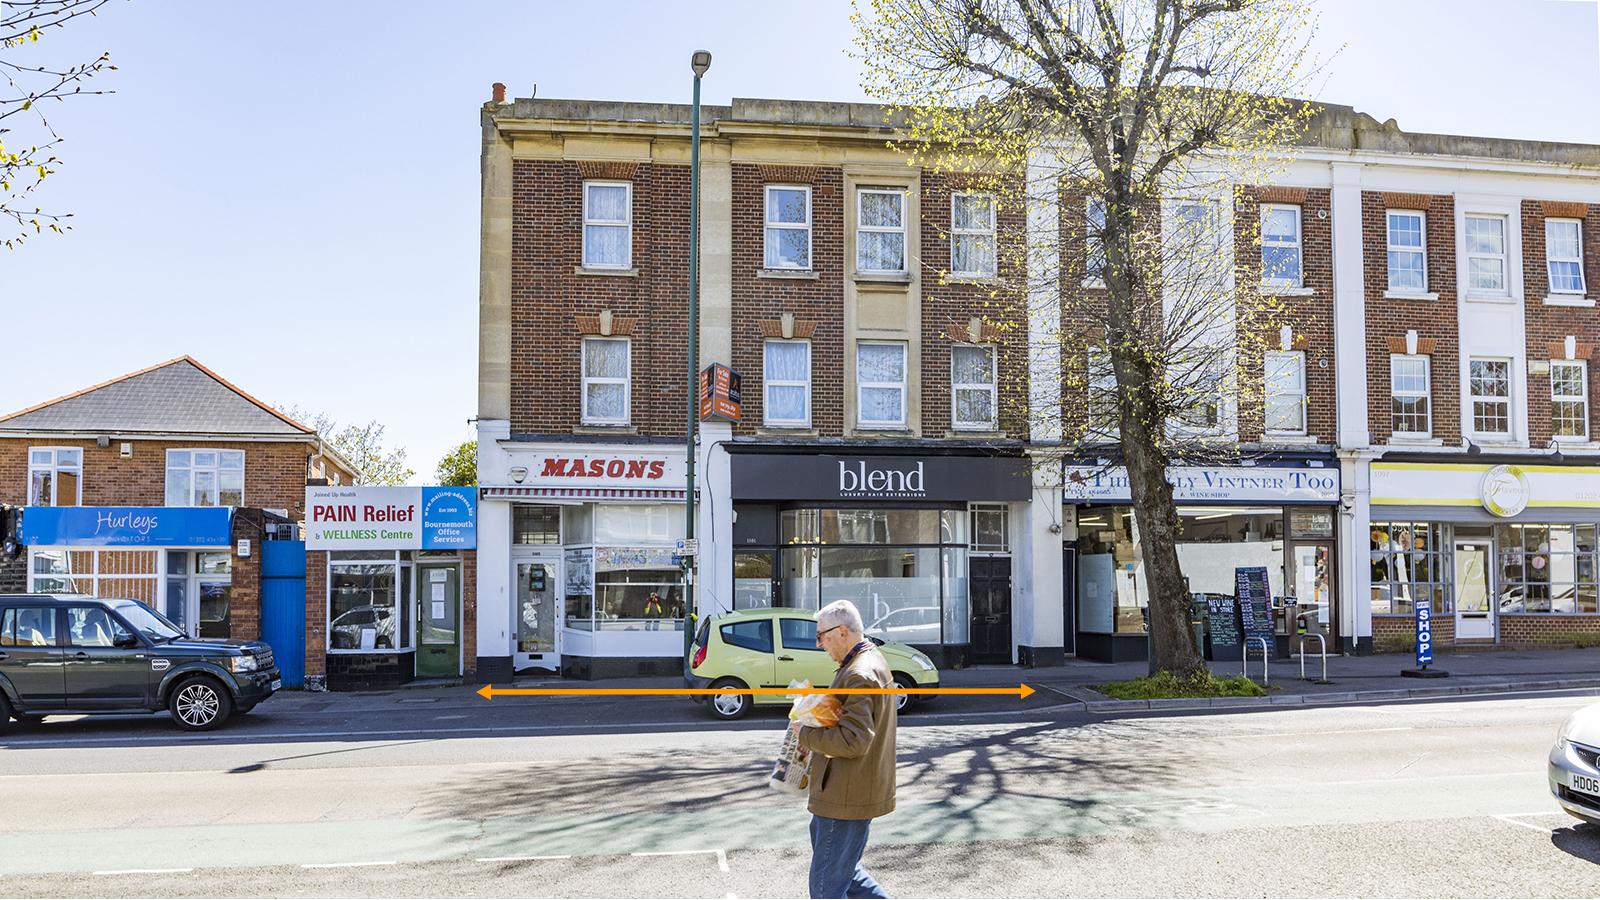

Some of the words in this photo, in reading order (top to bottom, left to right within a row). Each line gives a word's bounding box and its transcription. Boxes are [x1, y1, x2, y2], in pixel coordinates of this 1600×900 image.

[541, 458, 665, 480] MASONS
[838, 460, 925, 492] blend
[94, 511, 158, 535] Hurleys
[313, 505, 356, 522] PAIN
[363, 504, 414, 522] Relief
[322, 529, 377, 540] WELLNESS
[380, 529, 413, 540] Centre
[1208, 599, 1221, 607] NEW
[1418, 609, 1430, 654] SHOP
[1573, 774, 1600, 793] HD06
